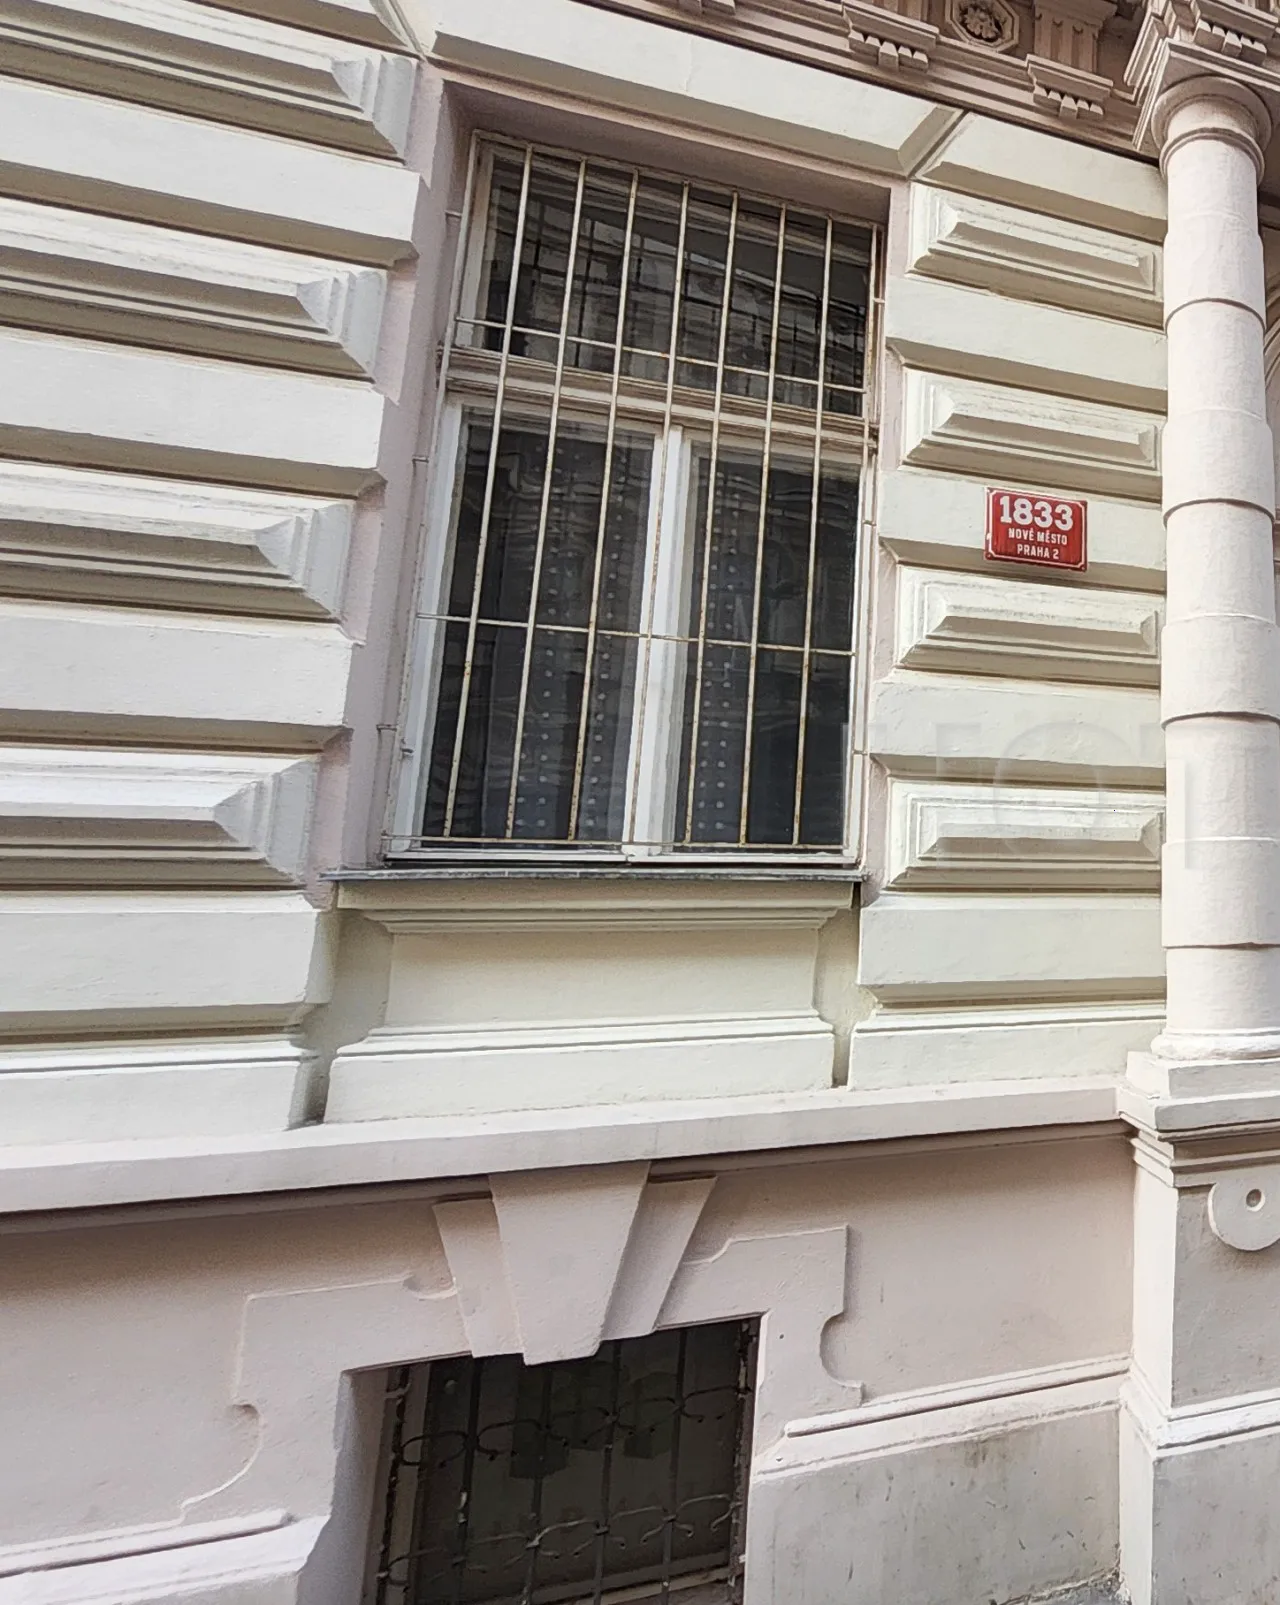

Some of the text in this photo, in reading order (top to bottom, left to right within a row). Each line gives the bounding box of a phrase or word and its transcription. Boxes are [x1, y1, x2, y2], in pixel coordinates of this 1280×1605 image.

[1000, 496, 1073, 531] 1833
[1008, 527, 1034, 542] NOVÉ
[1017, 543, 1060, 560] PRAHA 2
